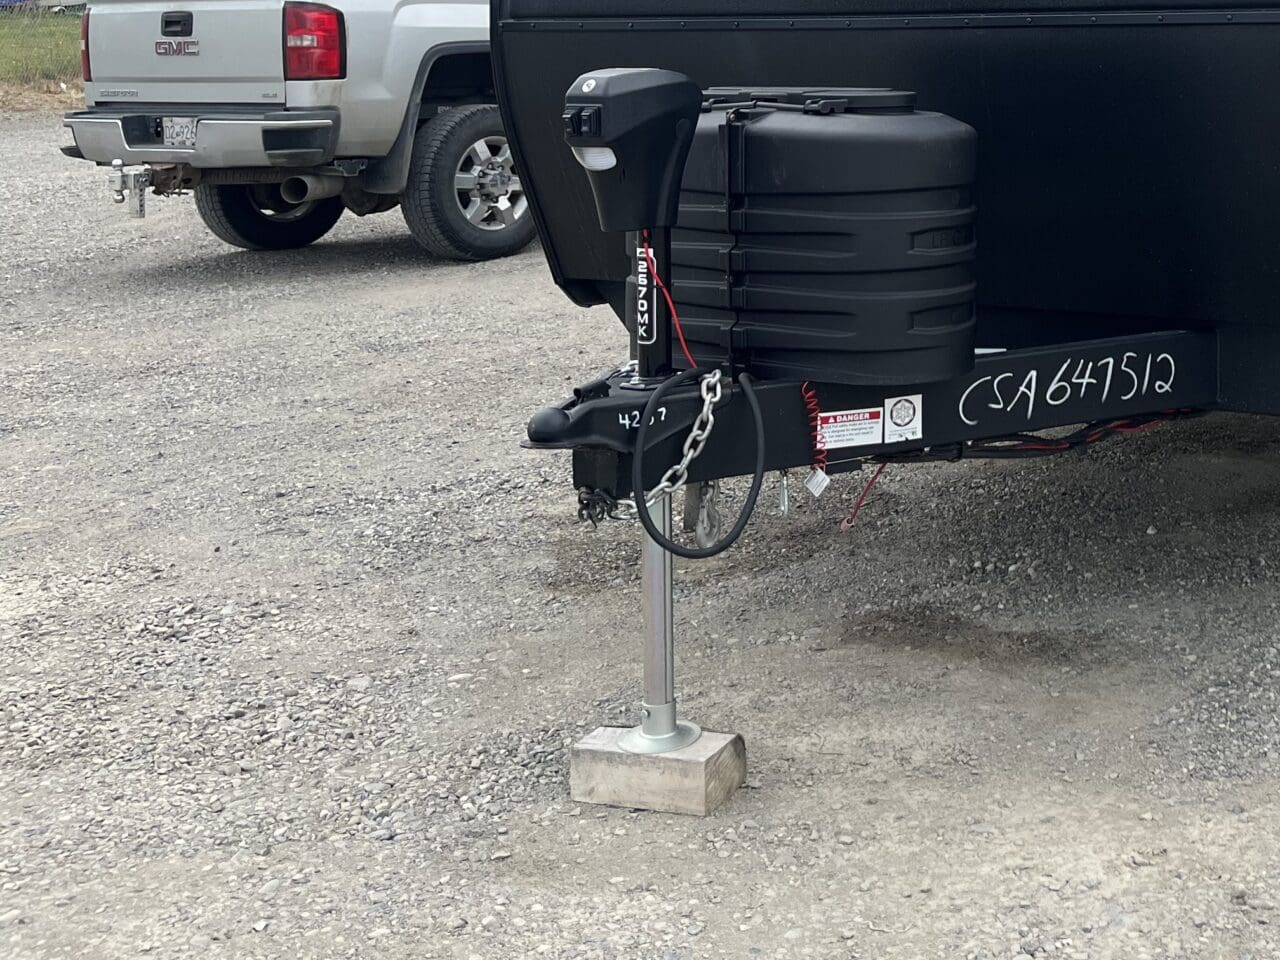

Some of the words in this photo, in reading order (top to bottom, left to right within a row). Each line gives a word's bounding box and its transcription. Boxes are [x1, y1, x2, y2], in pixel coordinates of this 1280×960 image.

[155, 39, 200, 56] GMC
[618, 406, 668, 431] 427
[836, 412, 870, 423] DANGER
